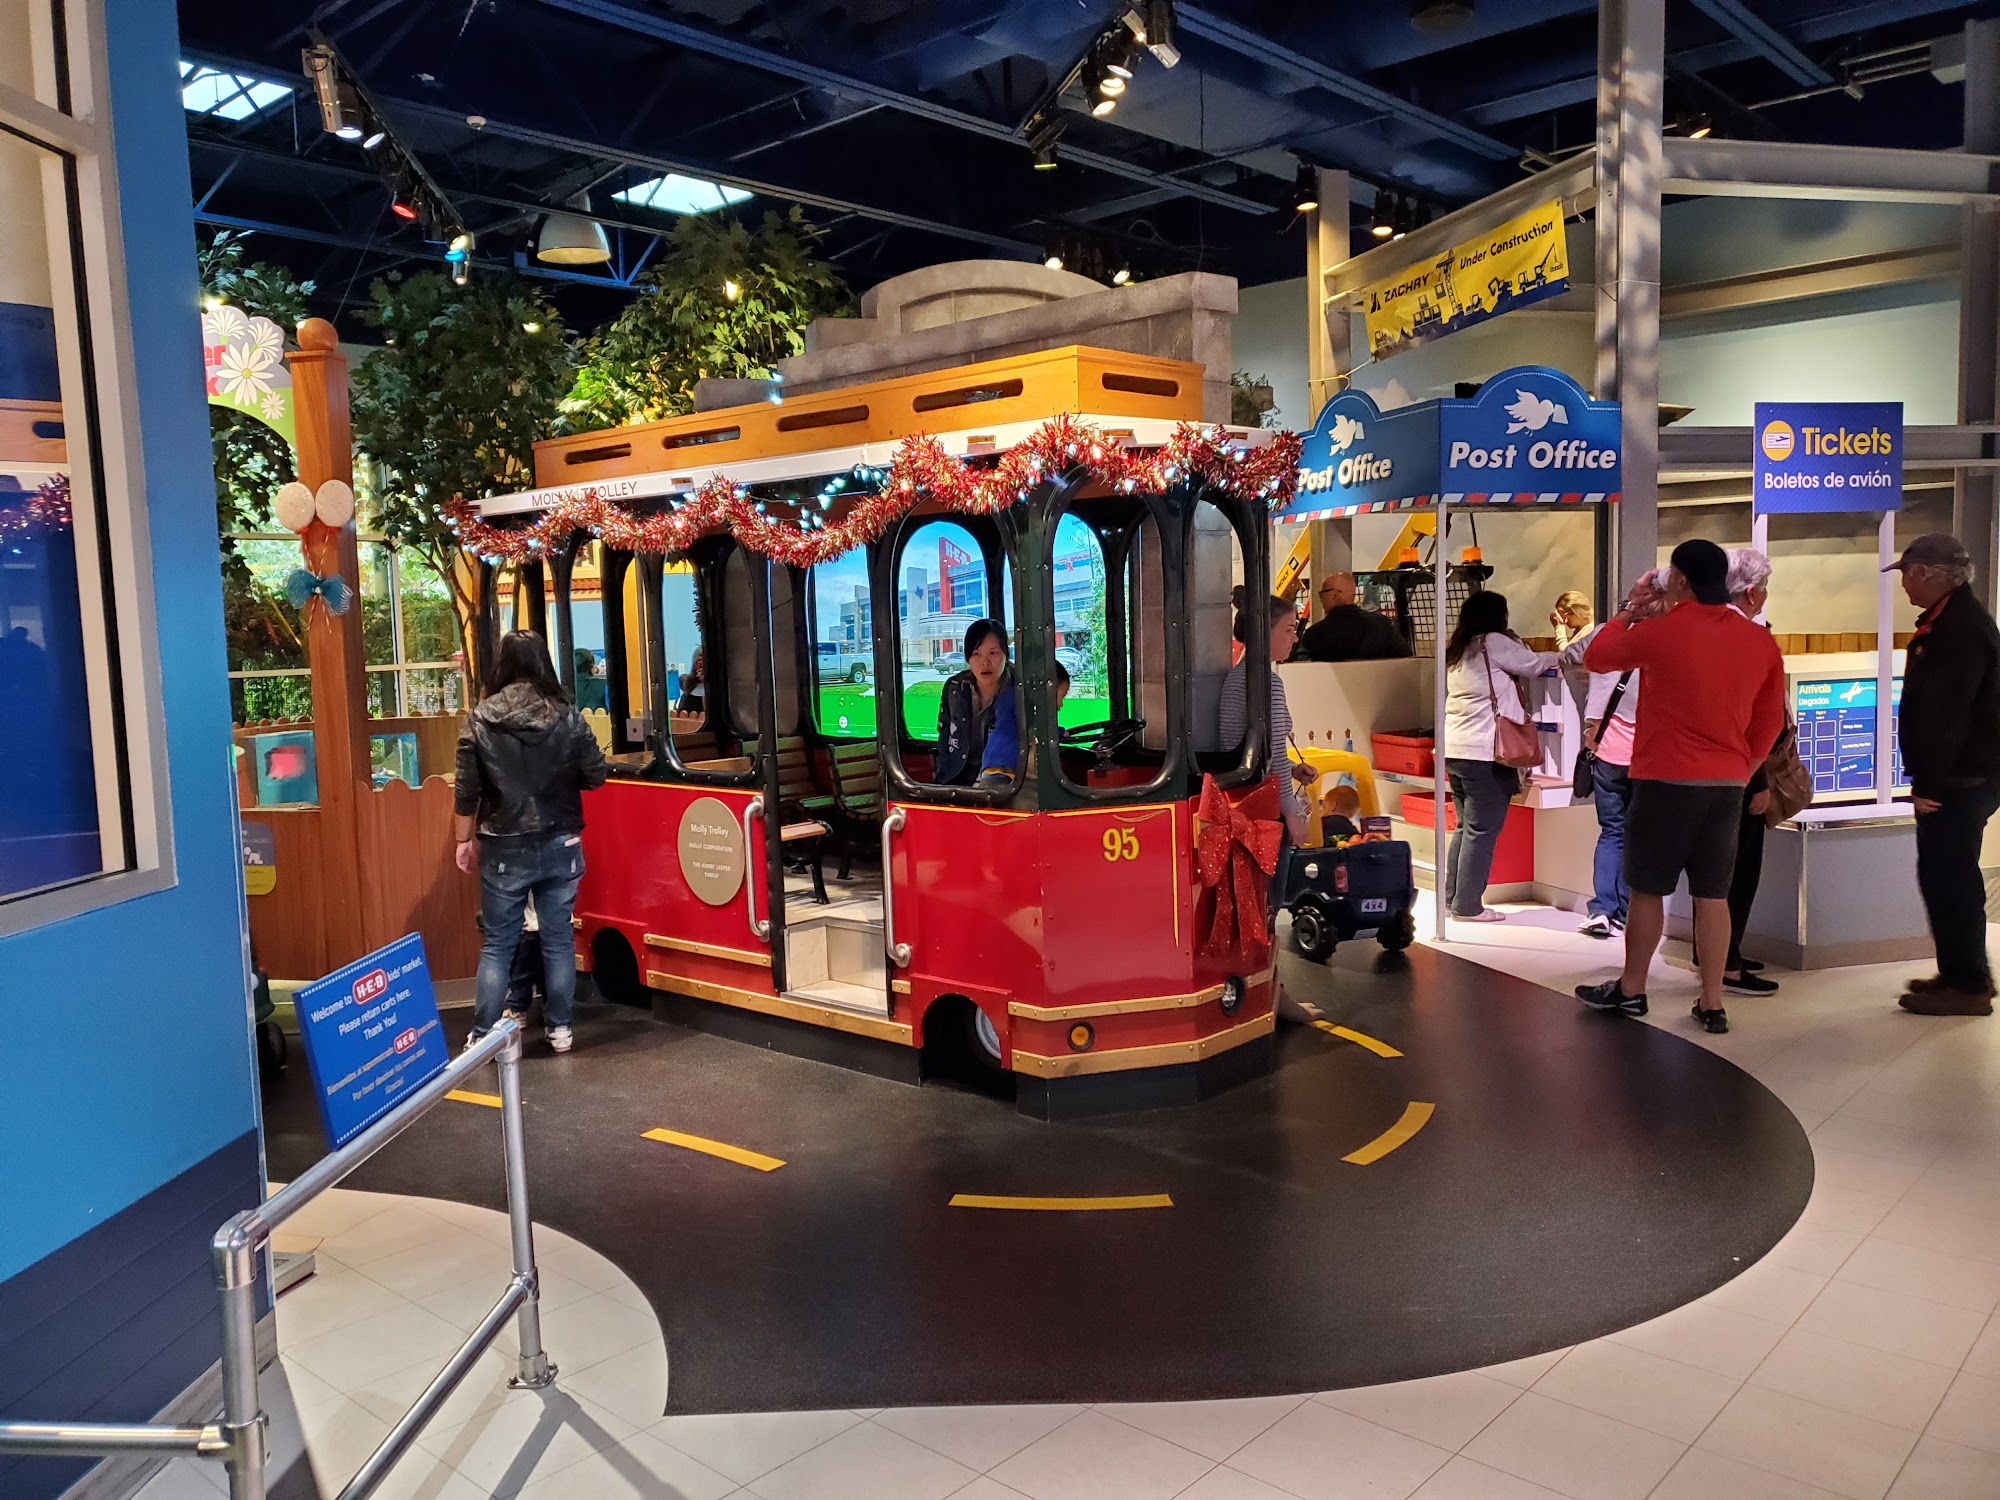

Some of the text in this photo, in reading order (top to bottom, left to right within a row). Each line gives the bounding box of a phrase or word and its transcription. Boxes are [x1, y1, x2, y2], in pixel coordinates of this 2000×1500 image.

[1384, 220, 1553, 303] ZACHRY Under Construction
[1449, 440, 1617, 470] Post Office
[1801, 426, 1892, 455] Tickets
[1298, 457, 1392, 493] Post Office
[1764, 469, 1891, 489] Boletos de avión
[1276, 570, 1289, 591] HOLT
[1798, 683, 1832, 695] Arrivals
[1798, 697, 1829, 707] Llegadas
[690, 823, 729, 838] Molly Trolley
[1103, 826, 1140, 862] 95
[311, 1000, 344, 1023] Welcome
[344, 994, 352, 1005] to
[387, 967, 401, 982] kids'
[401, 957, 423, 973] market.
[339, 988, 411, 1036] Please return carts here.
[363, 1013, 397, 1040] Thank You!
